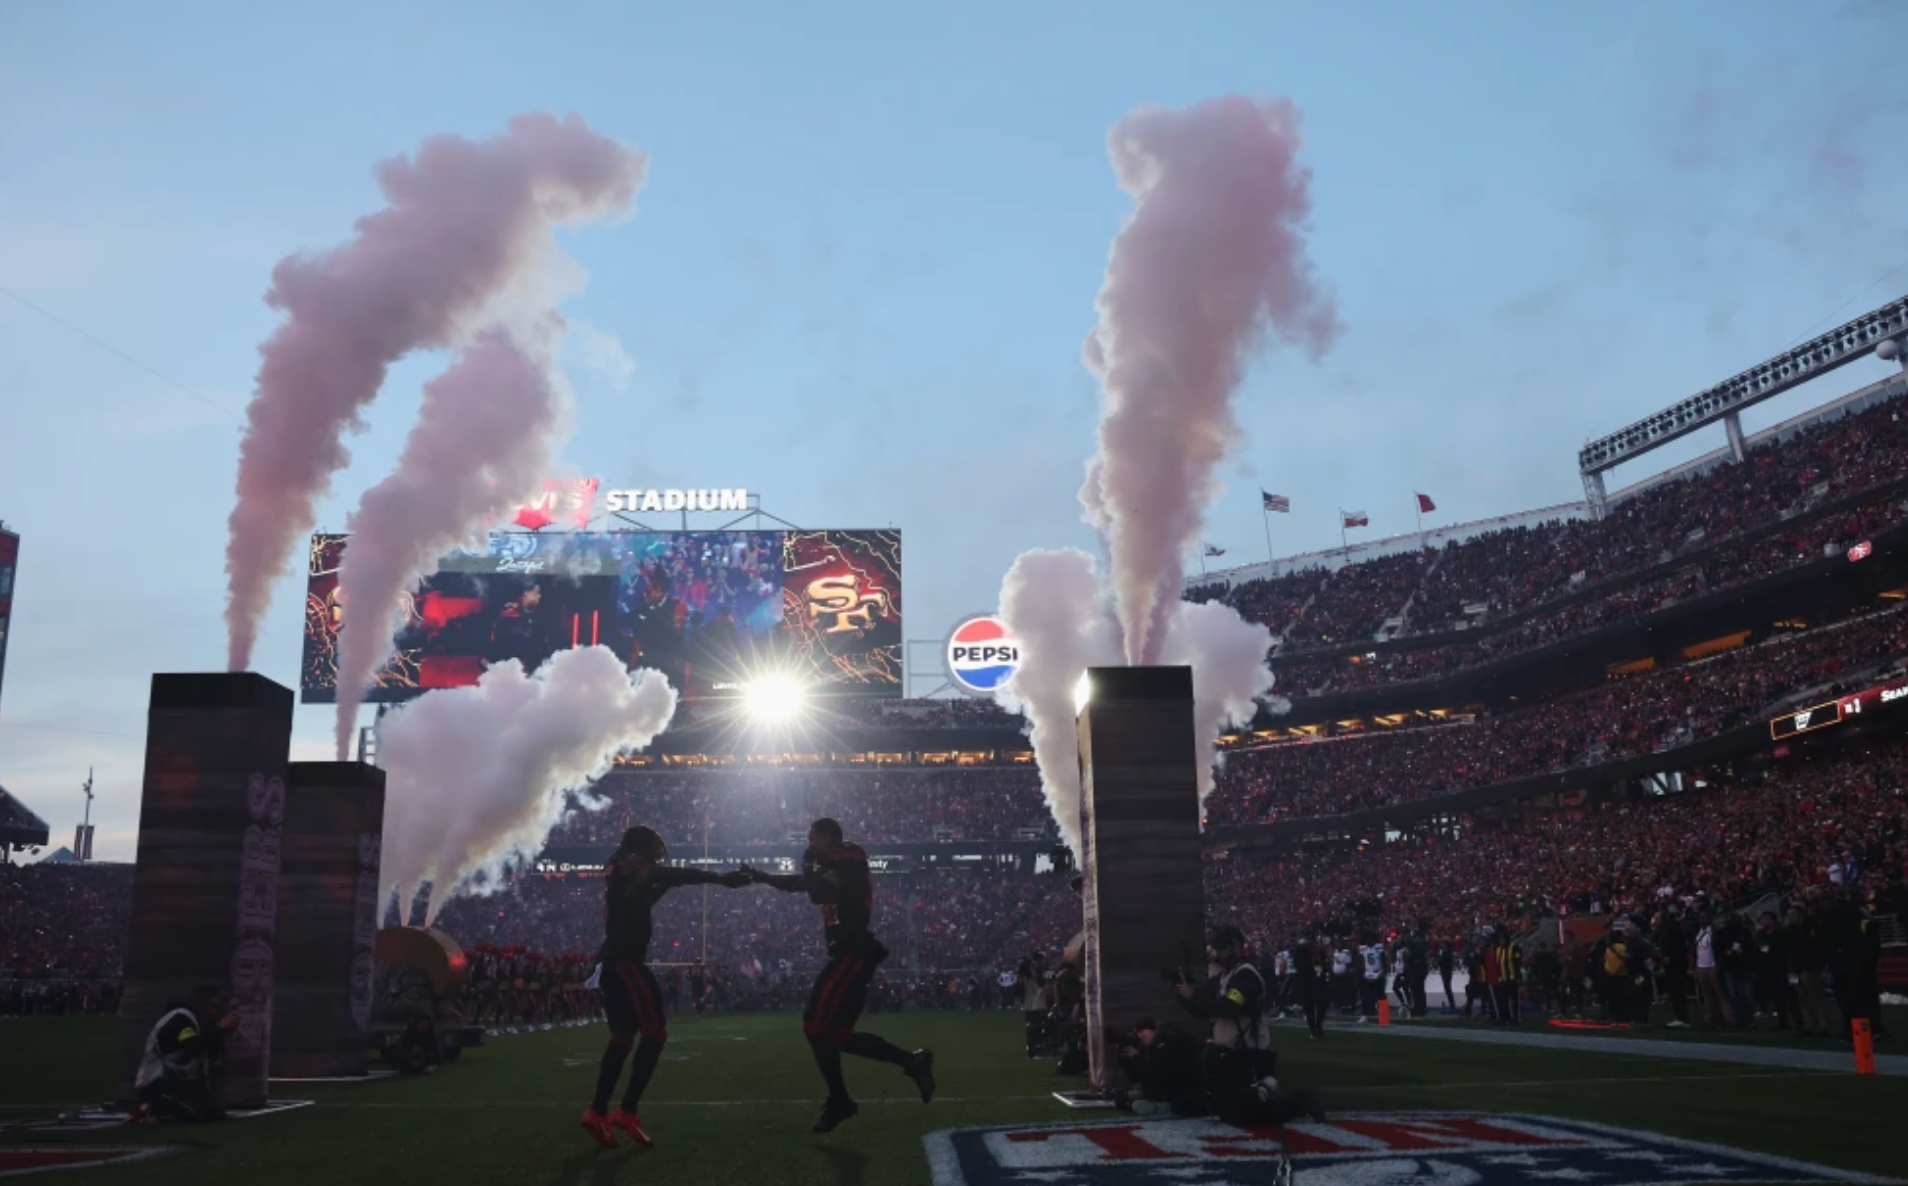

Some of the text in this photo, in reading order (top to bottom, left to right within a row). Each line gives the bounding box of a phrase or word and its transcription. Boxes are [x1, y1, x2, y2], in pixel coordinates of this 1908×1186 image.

[606, 488, 747, 511] STADIUM
[953, 647, 1018, 662] PEPSI
[230, 771, 286, 1049] 49ERS
